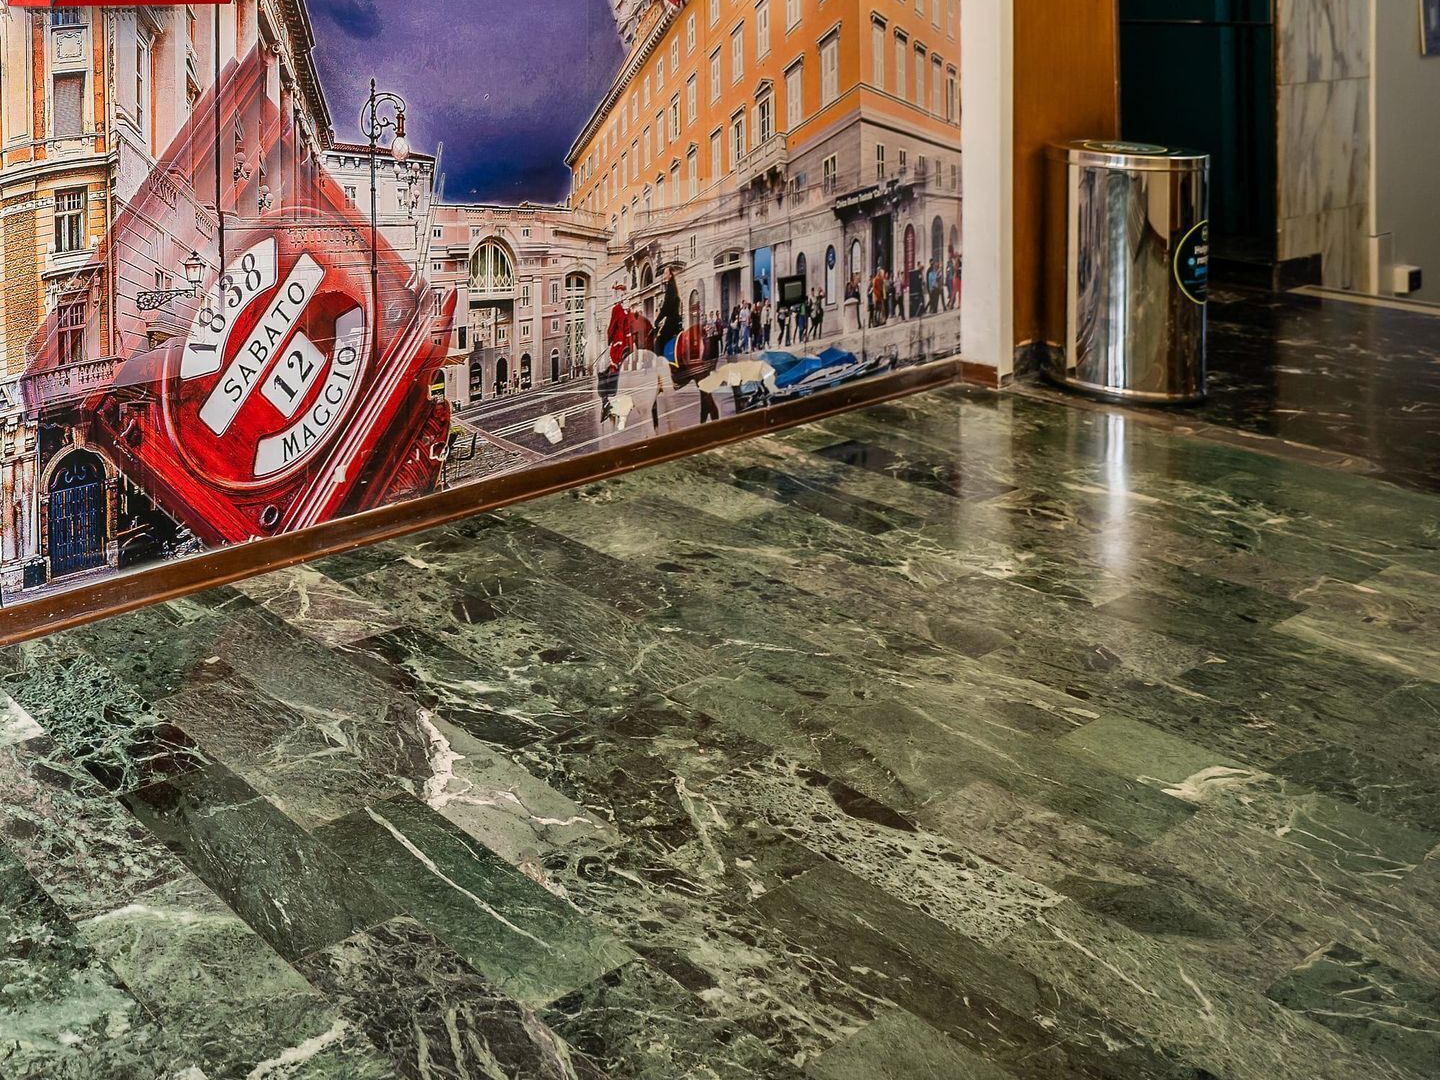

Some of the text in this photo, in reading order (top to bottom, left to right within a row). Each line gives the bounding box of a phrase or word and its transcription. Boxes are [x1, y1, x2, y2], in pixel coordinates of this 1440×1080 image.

[187, 253, 262, 355] 1838
[224, 281, 306, 404] SABATO
[272, 349, 315, 404] 12
[281, 345, 357, 464] MAGGIO
